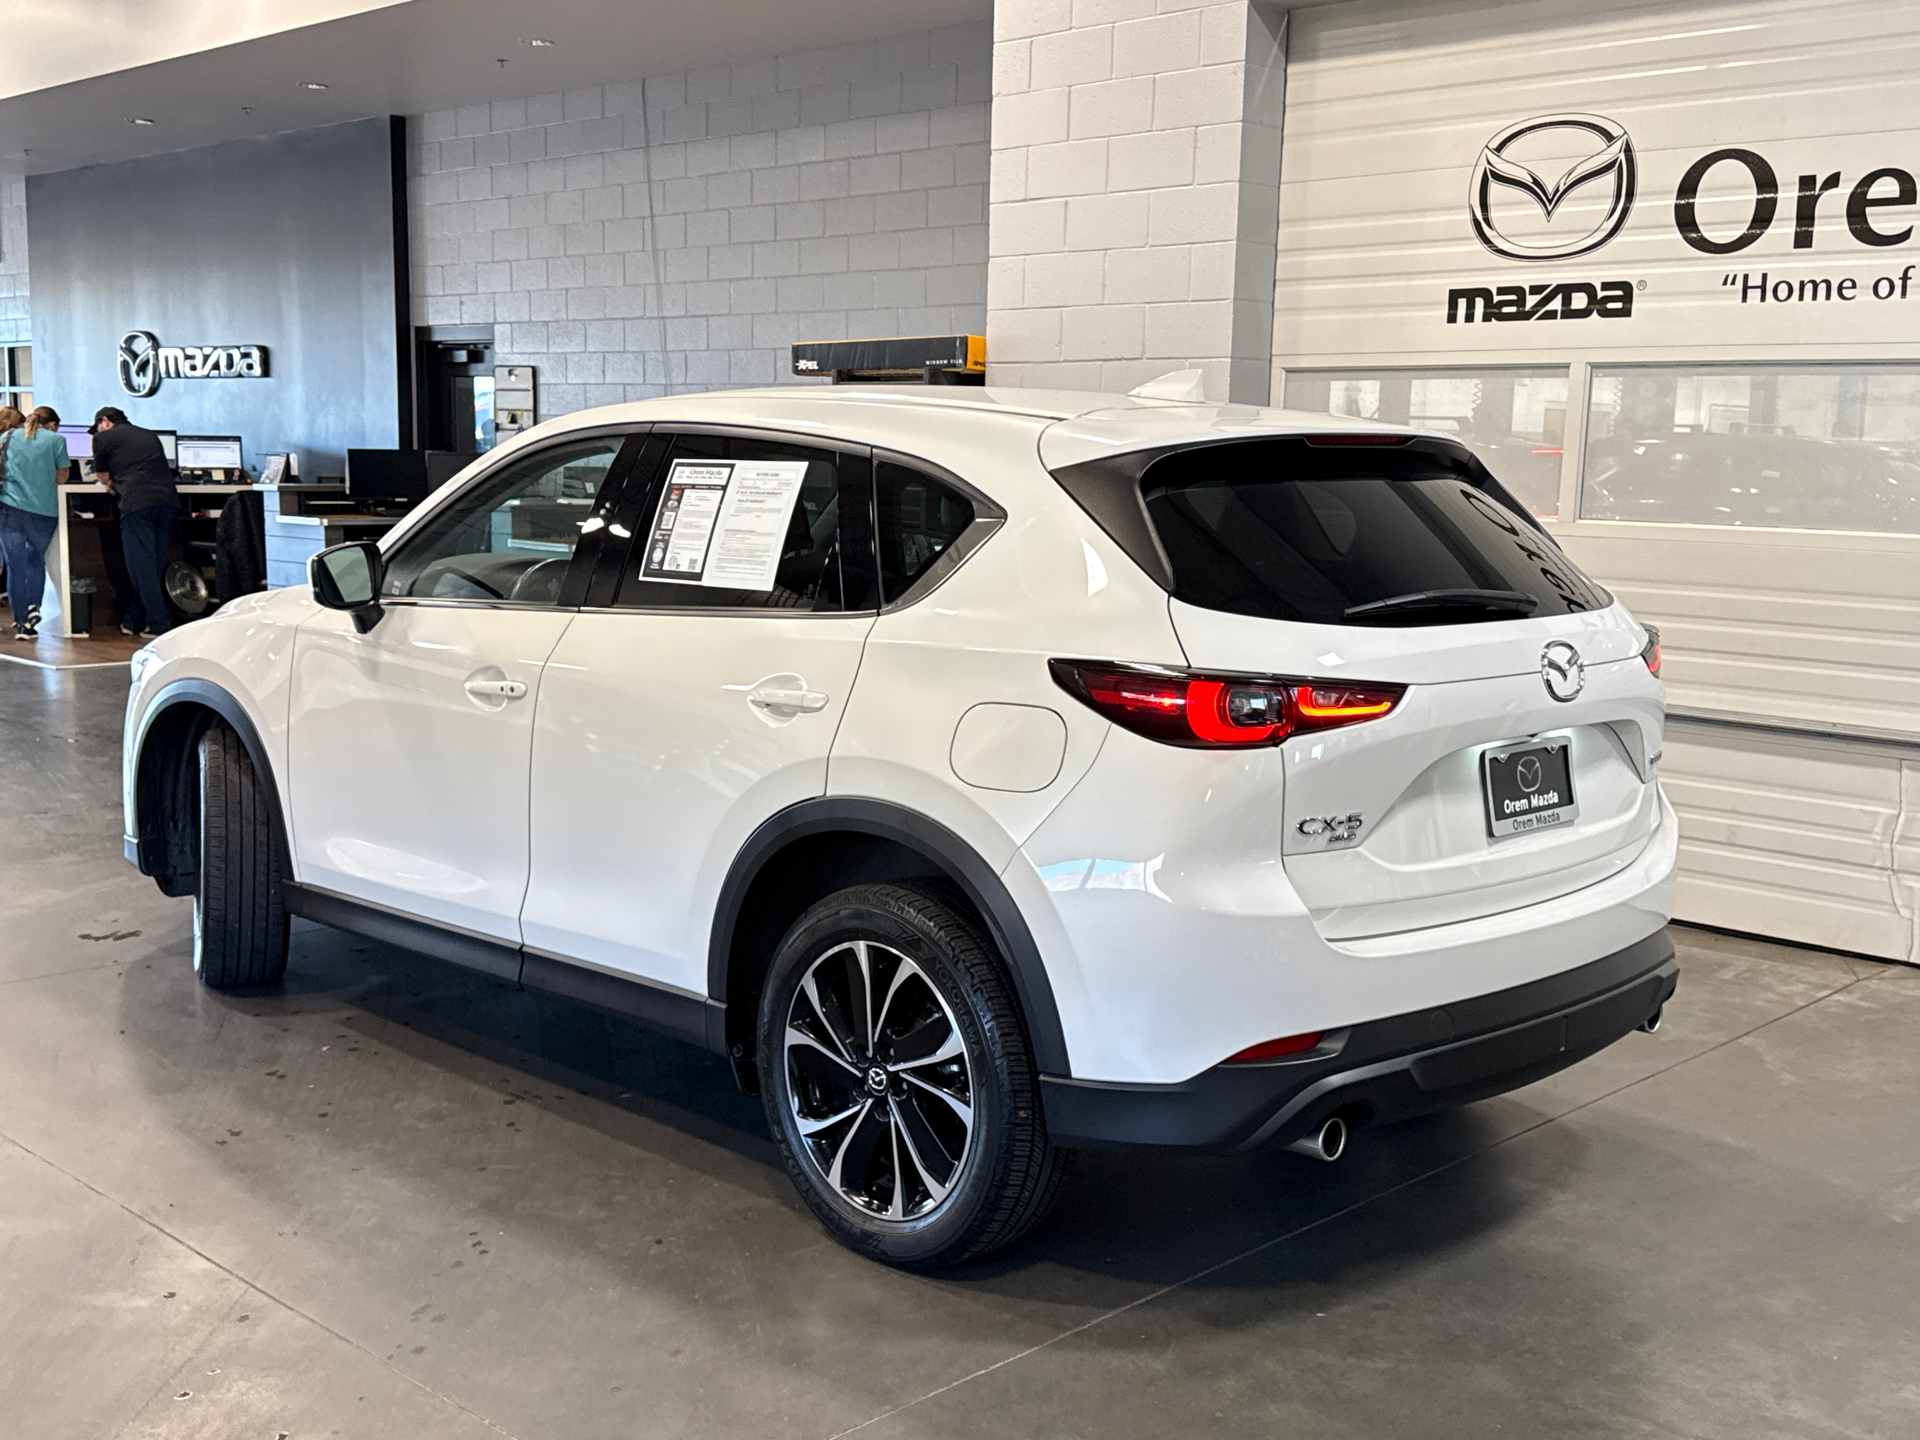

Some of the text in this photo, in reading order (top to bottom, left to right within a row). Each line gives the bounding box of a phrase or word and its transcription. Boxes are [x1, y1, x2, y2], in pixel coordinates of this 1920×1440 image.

[1872, 265, 1916, 300] of
[796, 359, 819, 370] XPEL
[689, 468, 705, 476] Orem
[1503, 790, 1559, 814] Orem Mazda
[1296, 812, 1363, 836] CX-5
[1512, 811, 1561, 831] Orem Mazda
[932, 958, 984, 1056] YOKOHAMA
